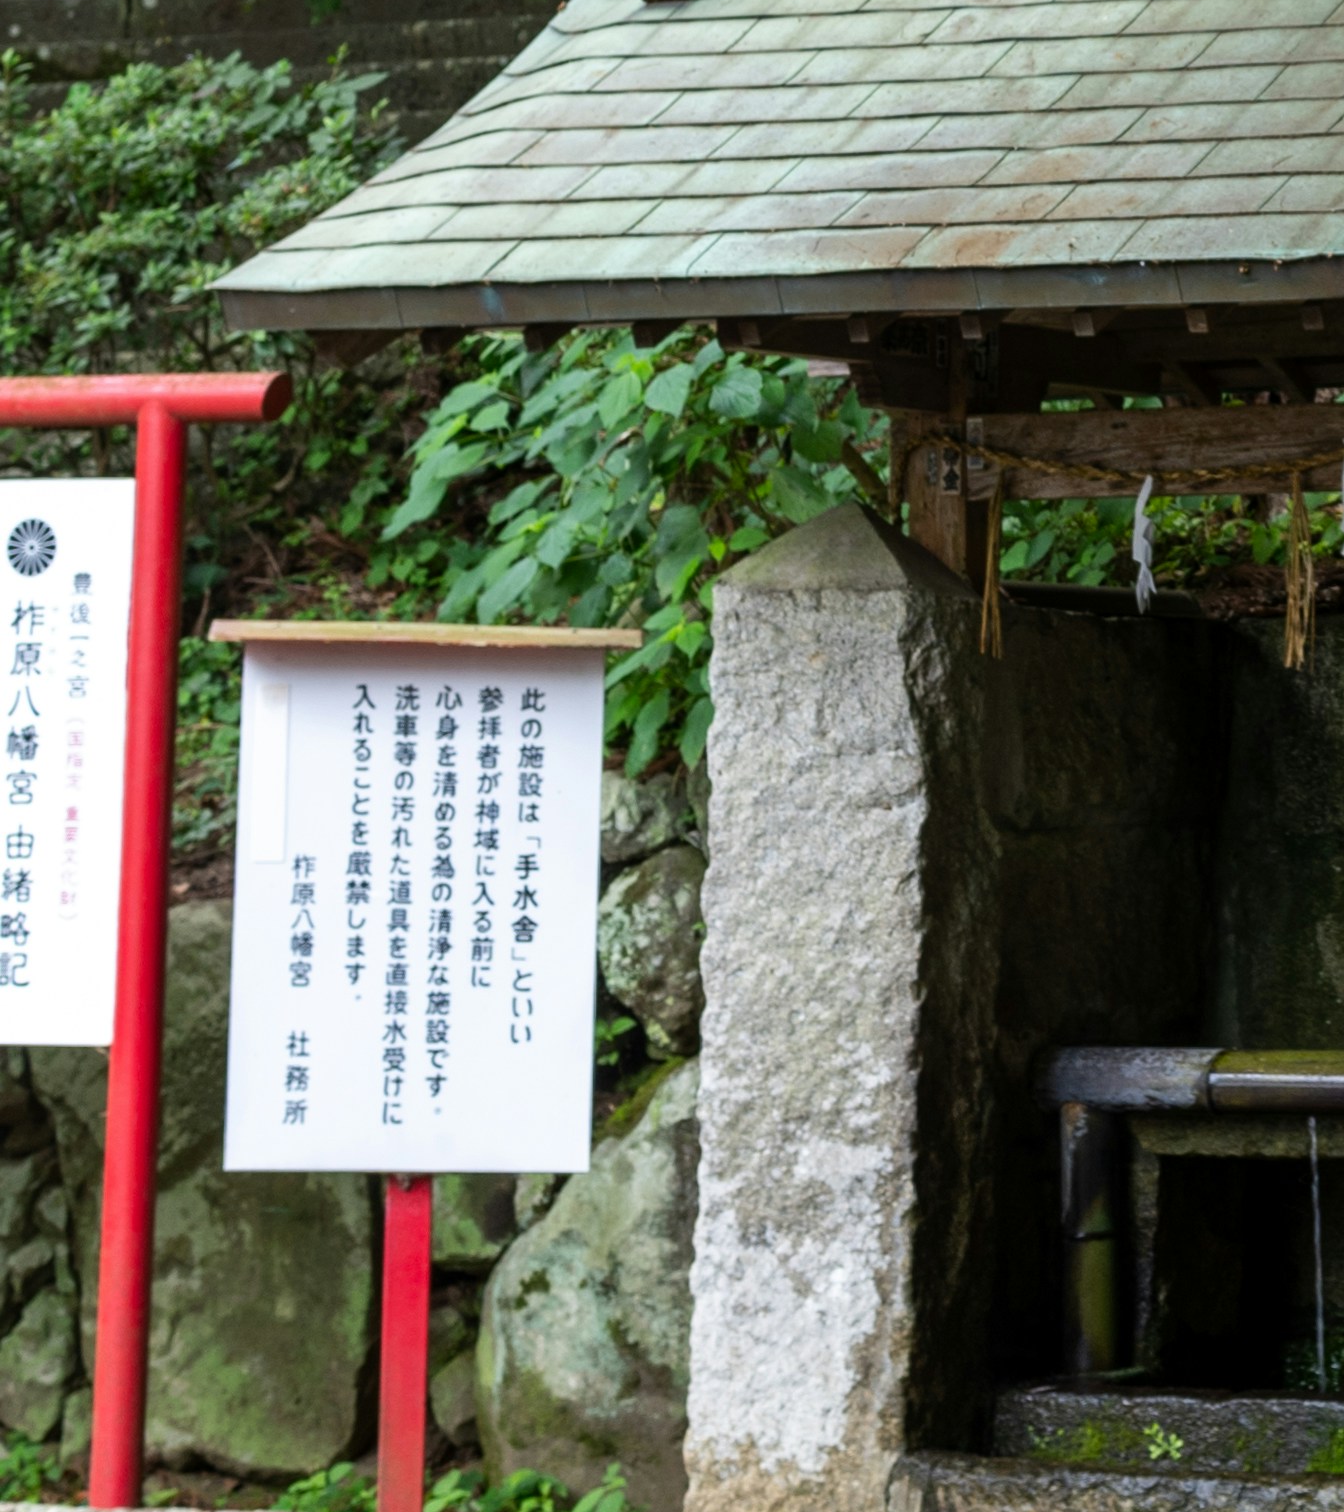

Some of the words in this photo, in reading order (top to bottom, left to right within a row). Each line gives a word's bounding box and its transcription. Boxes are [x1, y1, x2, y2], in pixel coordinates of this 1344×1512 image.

[6, 600, 45, 804] 柞原八幡宮
[289, 855, 317, 987] 柞原八幡宮
[382, 684, 420, 1125] 洗車等の汚れた道具を直接水受けに
[510, 687, 546, 1044] 此の施設は「手水舎」といい
[283, 1030, 310, 1125] 社務所
